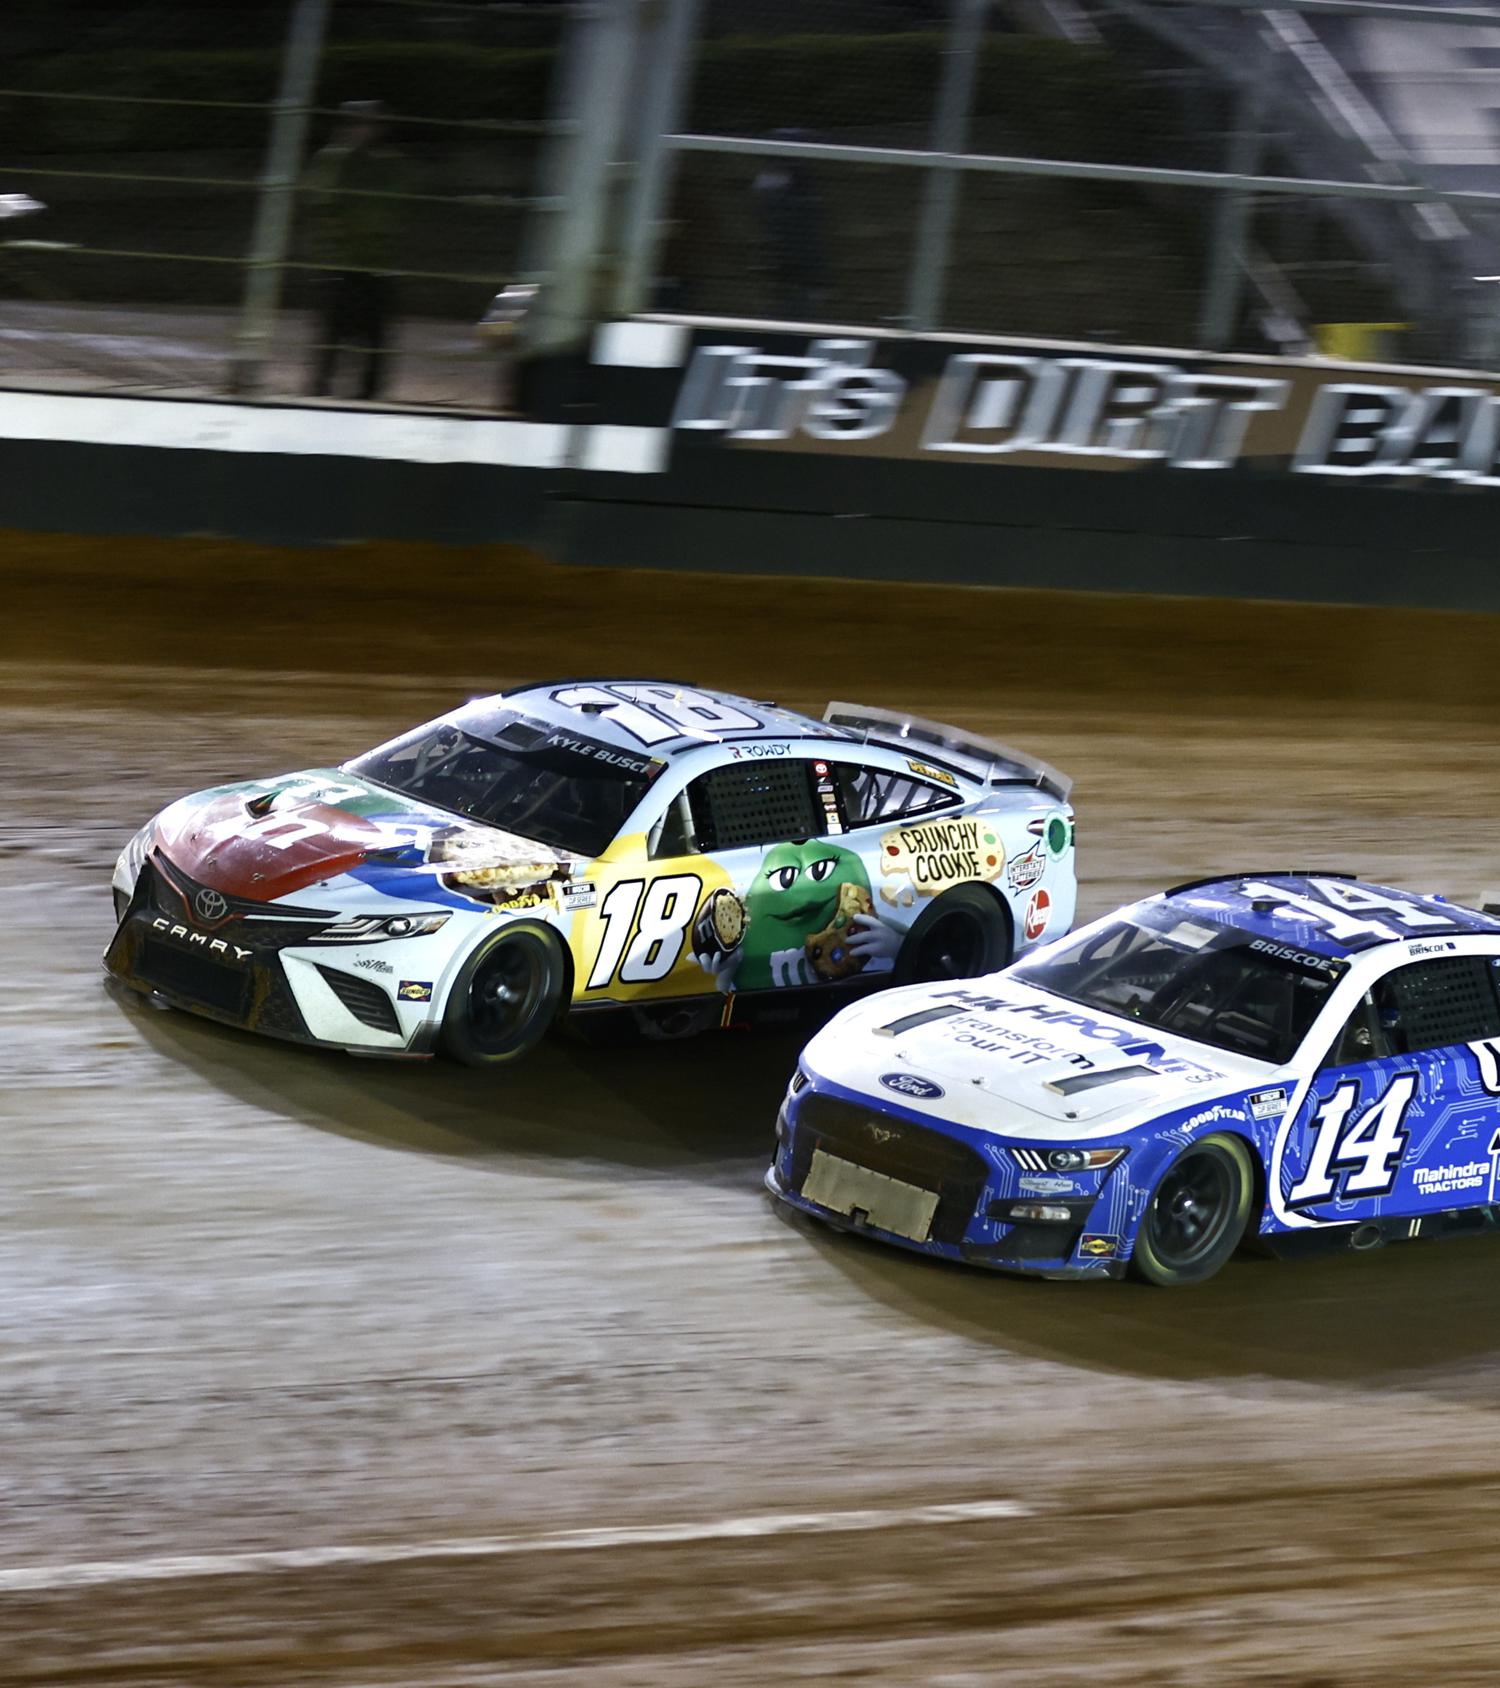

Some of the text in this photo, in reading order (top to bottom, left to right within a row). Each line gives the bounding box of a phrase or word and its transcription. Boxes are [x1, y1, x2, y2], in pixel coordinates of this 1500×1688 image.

[920, 352, 1292, 469] DIRT
[549, 684, 766, 748] 18
[548, 734, 593, 756] KYLE
[743, 743, 792, 757] ROWDY
[899, 822, 980, 855] CRUNCHY
[915, 851, 982, 884] COOKIE
[1239, 878, 1457, 941] 14
[152, 917, 253, 960] CAMRY
[585, 873, 703, 991] 18
[1249, 938, 1332, 972] BRISCOE
[1409, 945, 1445, 957] BRISCOE
[948, 1016, 1096, 1070] Transform
[1009, 1050, 1051, 1065] IT
[889, 1074, 934, 1097] Ford
[1181, 1104, 1247, 1134] GOODYEAR
[1286, 1071, 1420, 1211] 14
[1413, 1161, 1490, 1185] Mahindra
[1418, 1175, 1483, 1195] TRACTORS
